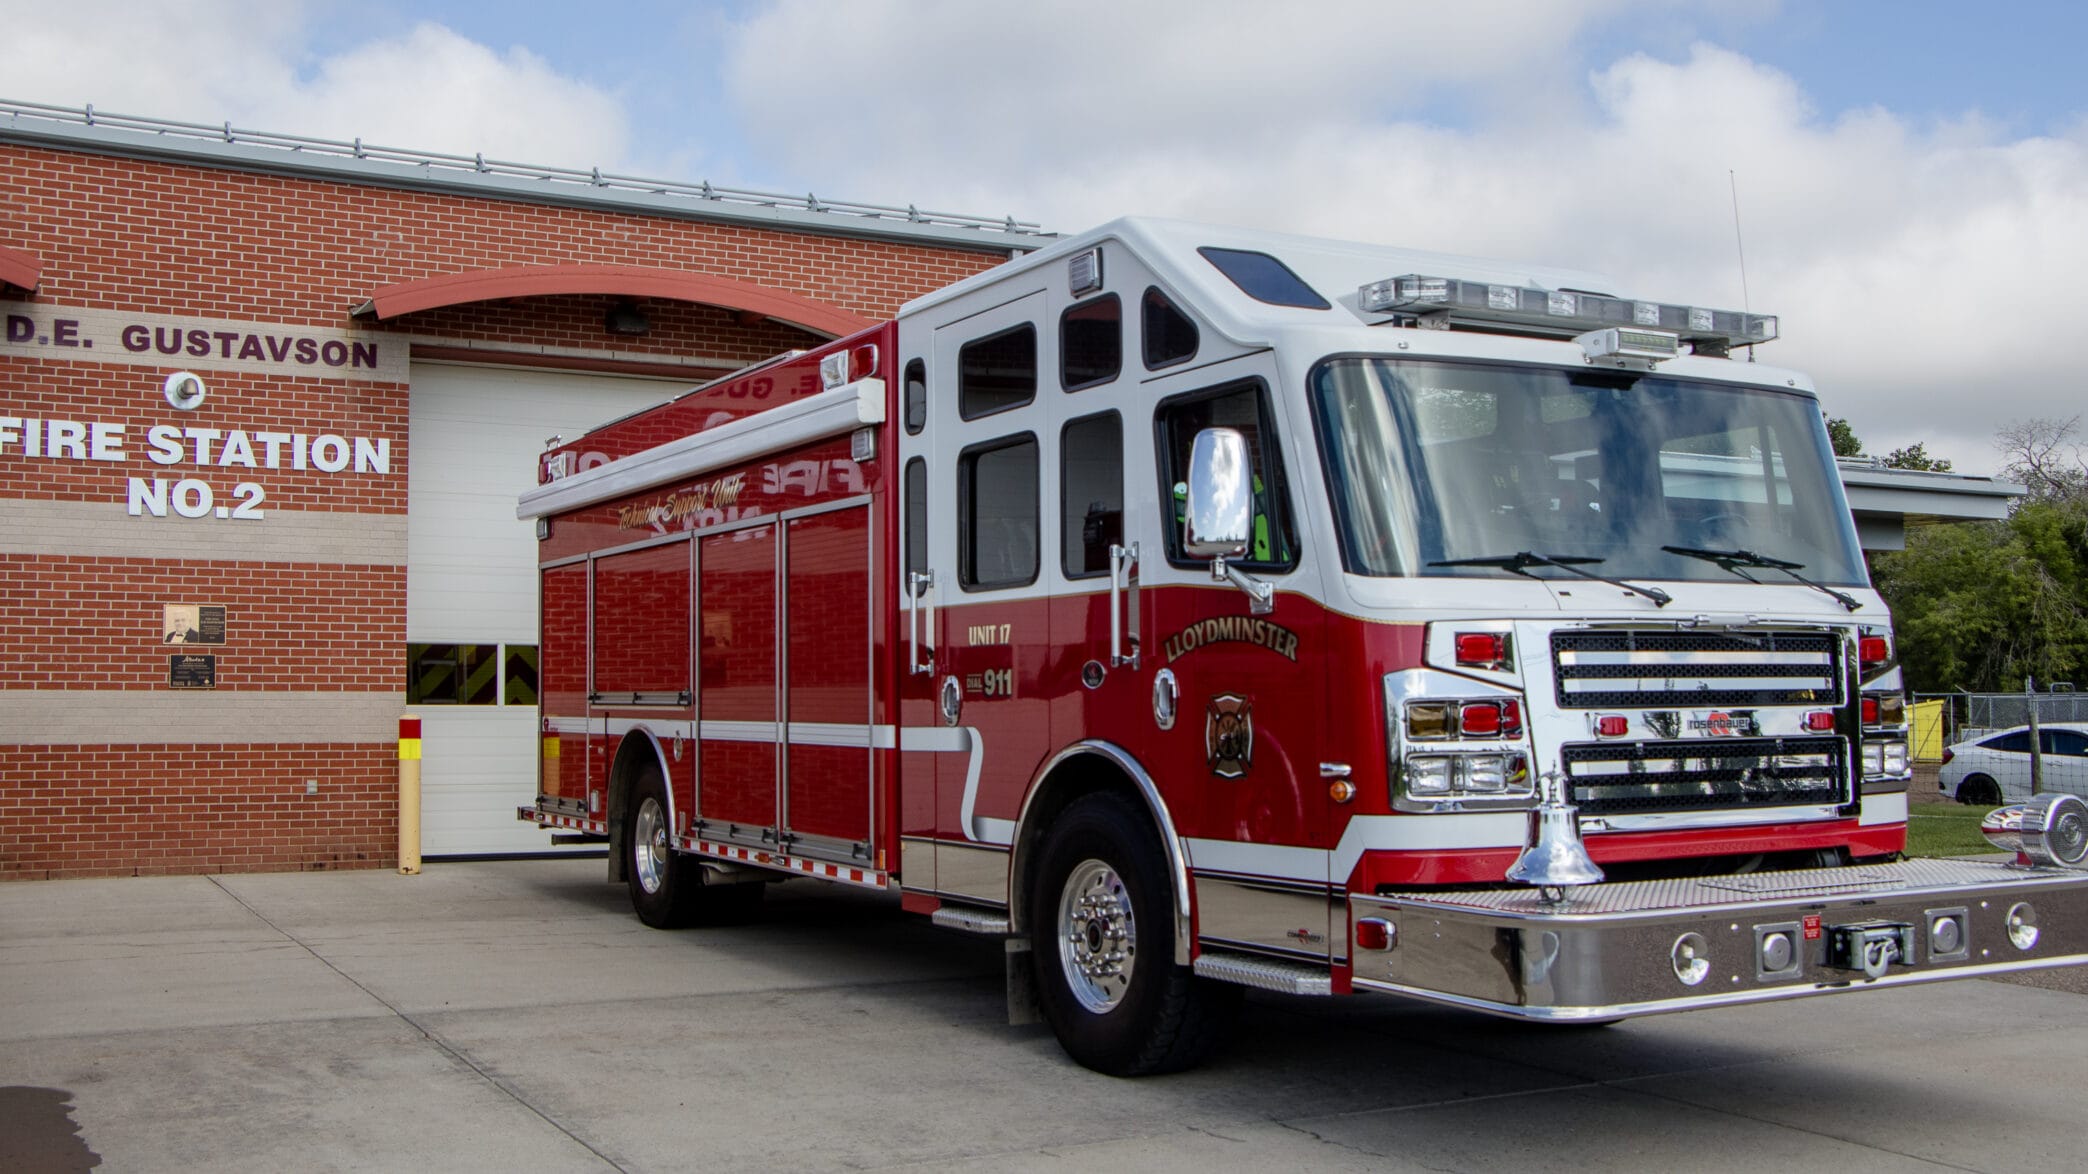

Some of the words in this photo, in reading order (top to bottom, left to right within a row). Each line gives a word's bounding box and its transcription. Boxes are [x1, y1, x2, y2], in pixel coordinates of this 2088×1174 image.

[7, 314, 93, 348] D.E.
[121, 324, 378, 369] GUSTAVSON
[0, 416, 127, 462] FIRE
[146, 424, 391, 475] STATION
[128, 477, 266, 520] NO.2
[618, 496, 660, 530] Technical
[661, 492, 709, 524] Support
[711, 477, 740, 509] Unit
[968, 625, 996, 646] UNIT
[1000, 623, 1012, 645] 17
[1164, 616, 1299, 663] LLOYDMINSTER
[966, 677, 983, 689] DIAL
[984, 668, 1013, 696] 911
[1688, 717, 1750, 730] rosenbauer
